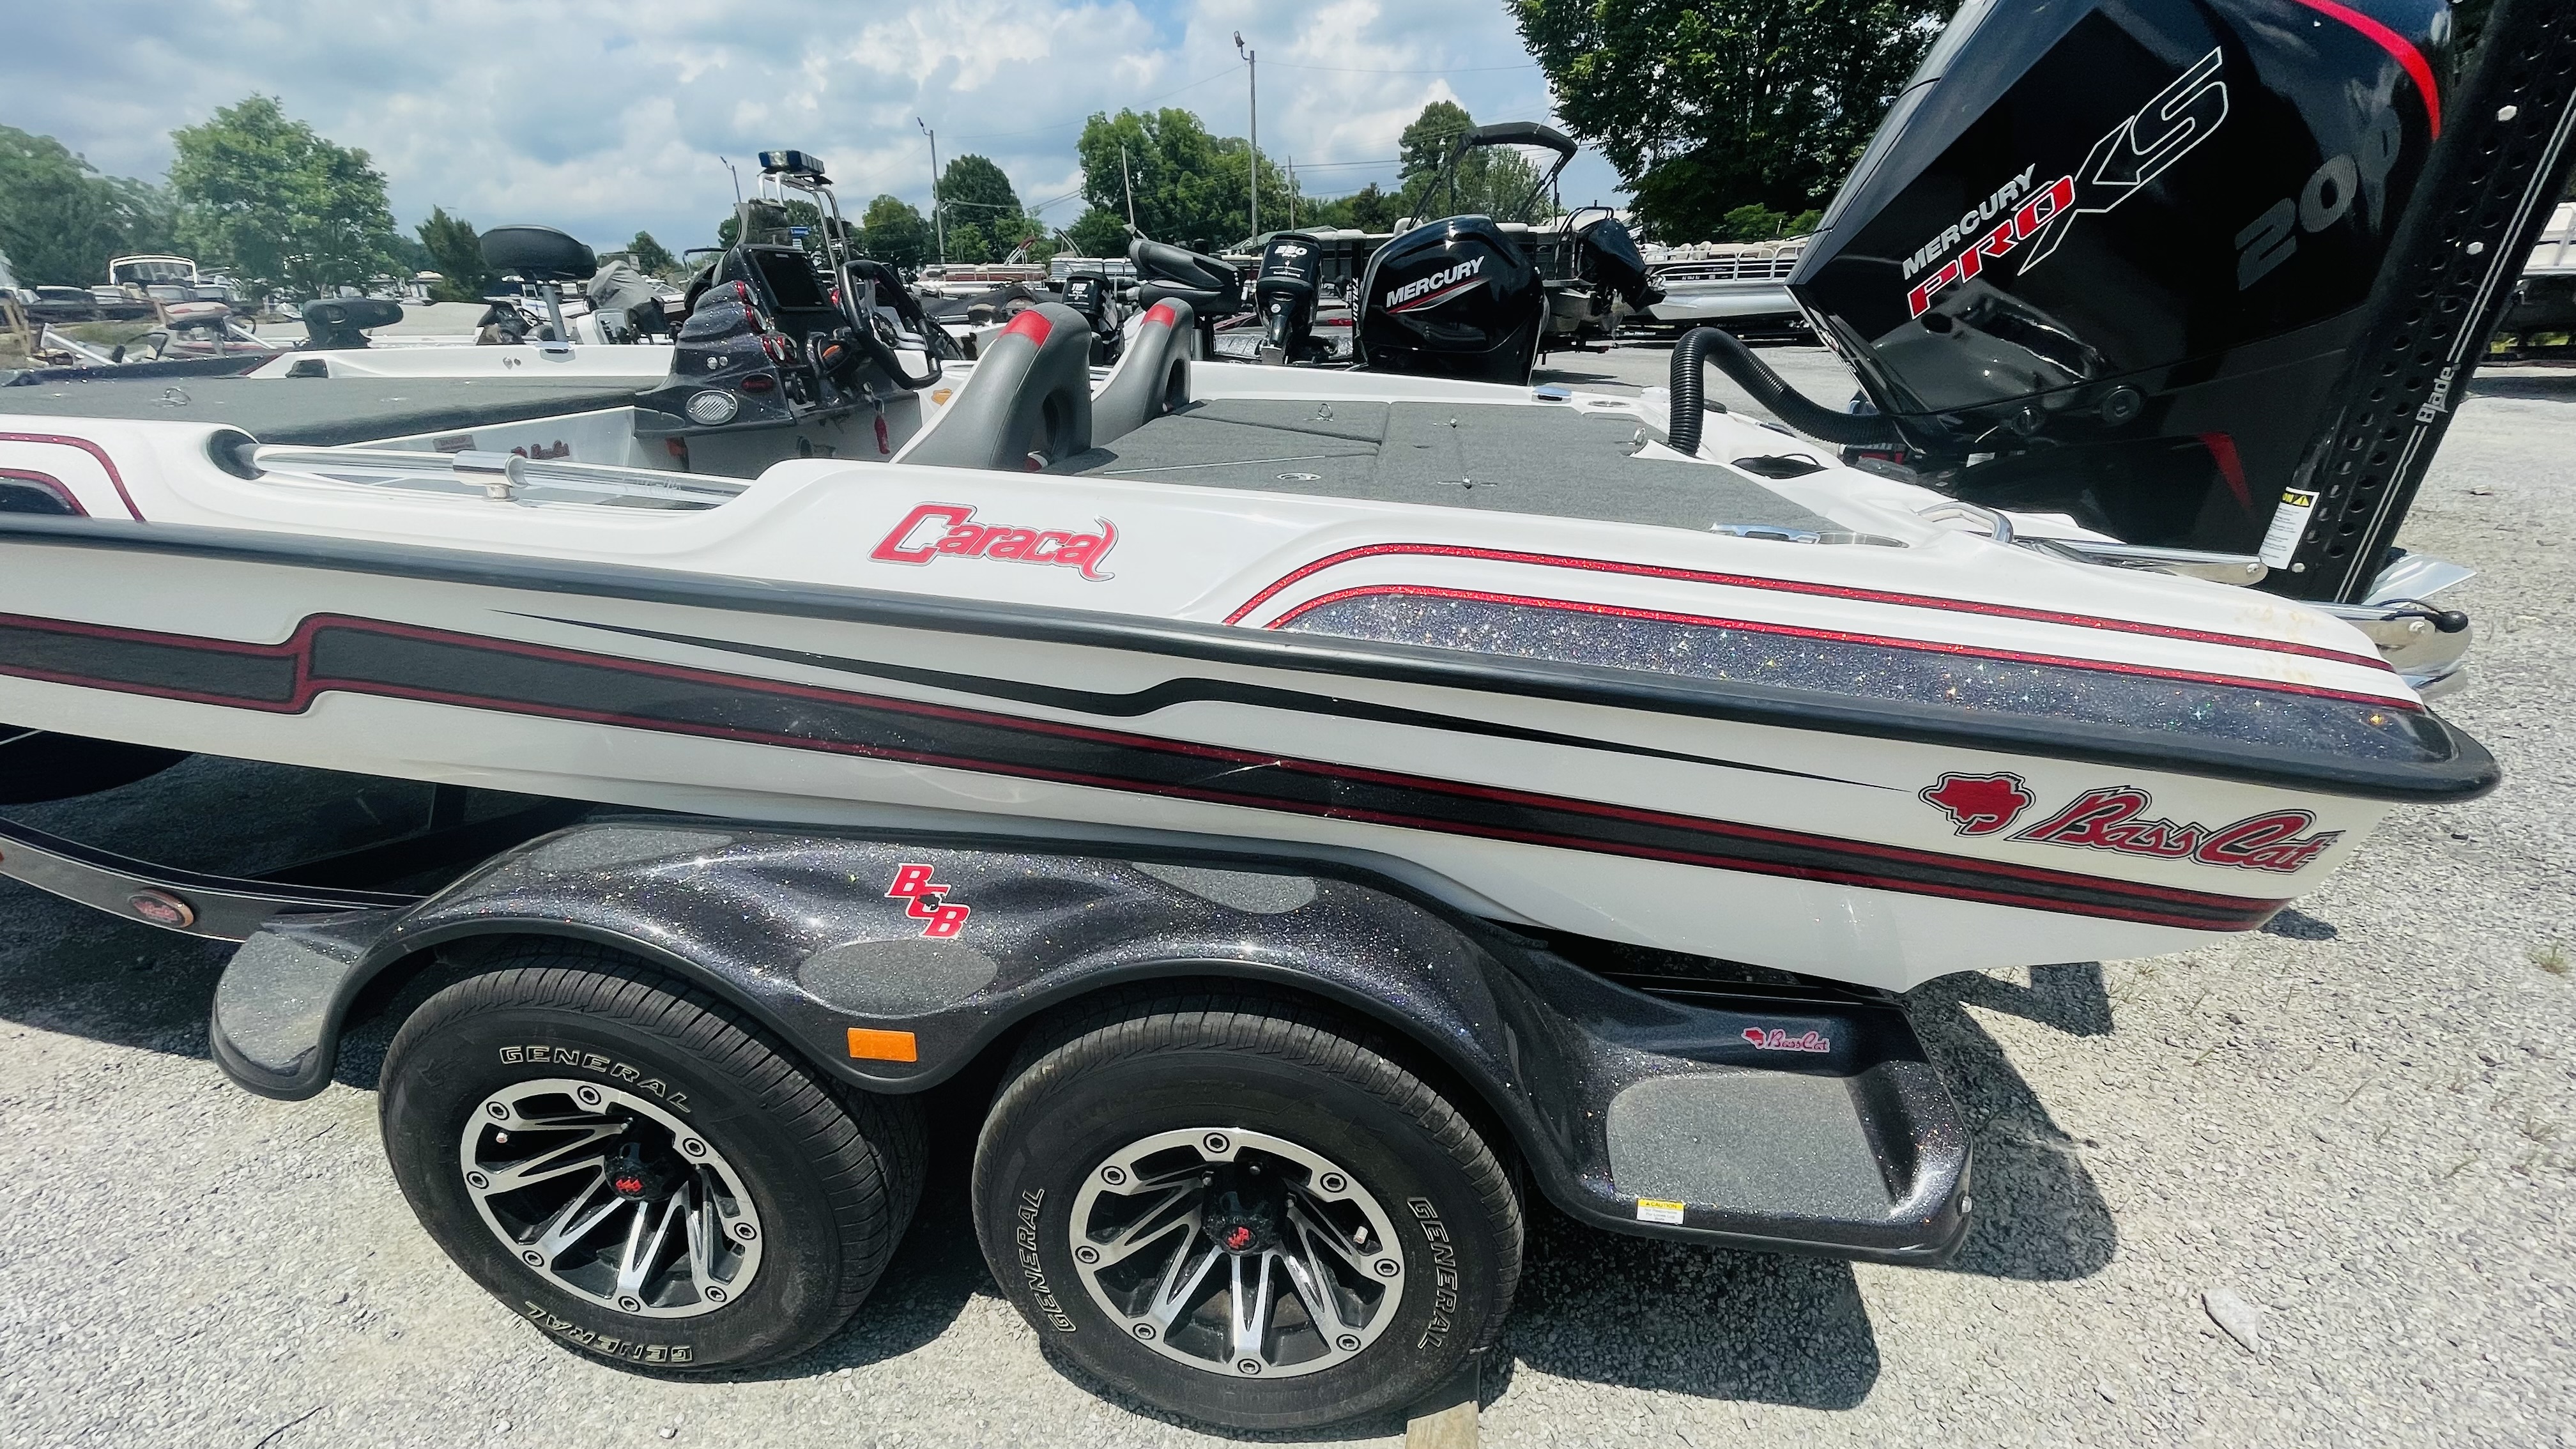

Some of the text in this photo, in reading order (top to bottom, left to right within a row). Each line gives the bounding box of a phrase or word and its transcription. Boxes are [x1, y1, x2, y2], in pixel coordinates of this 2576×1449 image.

[1902, 163, 2035, 280] MERCURY
[1907, 46, 2228, 319] PRO XS
[1386, 256, 1485, 308] MERCURY
[2416, 365, 2455, 423] Blade
[867, 501, 1119, 582] Caracal
[499, 1045, 692, 1114] GENERAL
[1016, 1188, 1077, 1332] GENERAL
[1406, 1197, 1458, 1349] GENERAL
[525, 1300, 693, 1363] GENERAL
